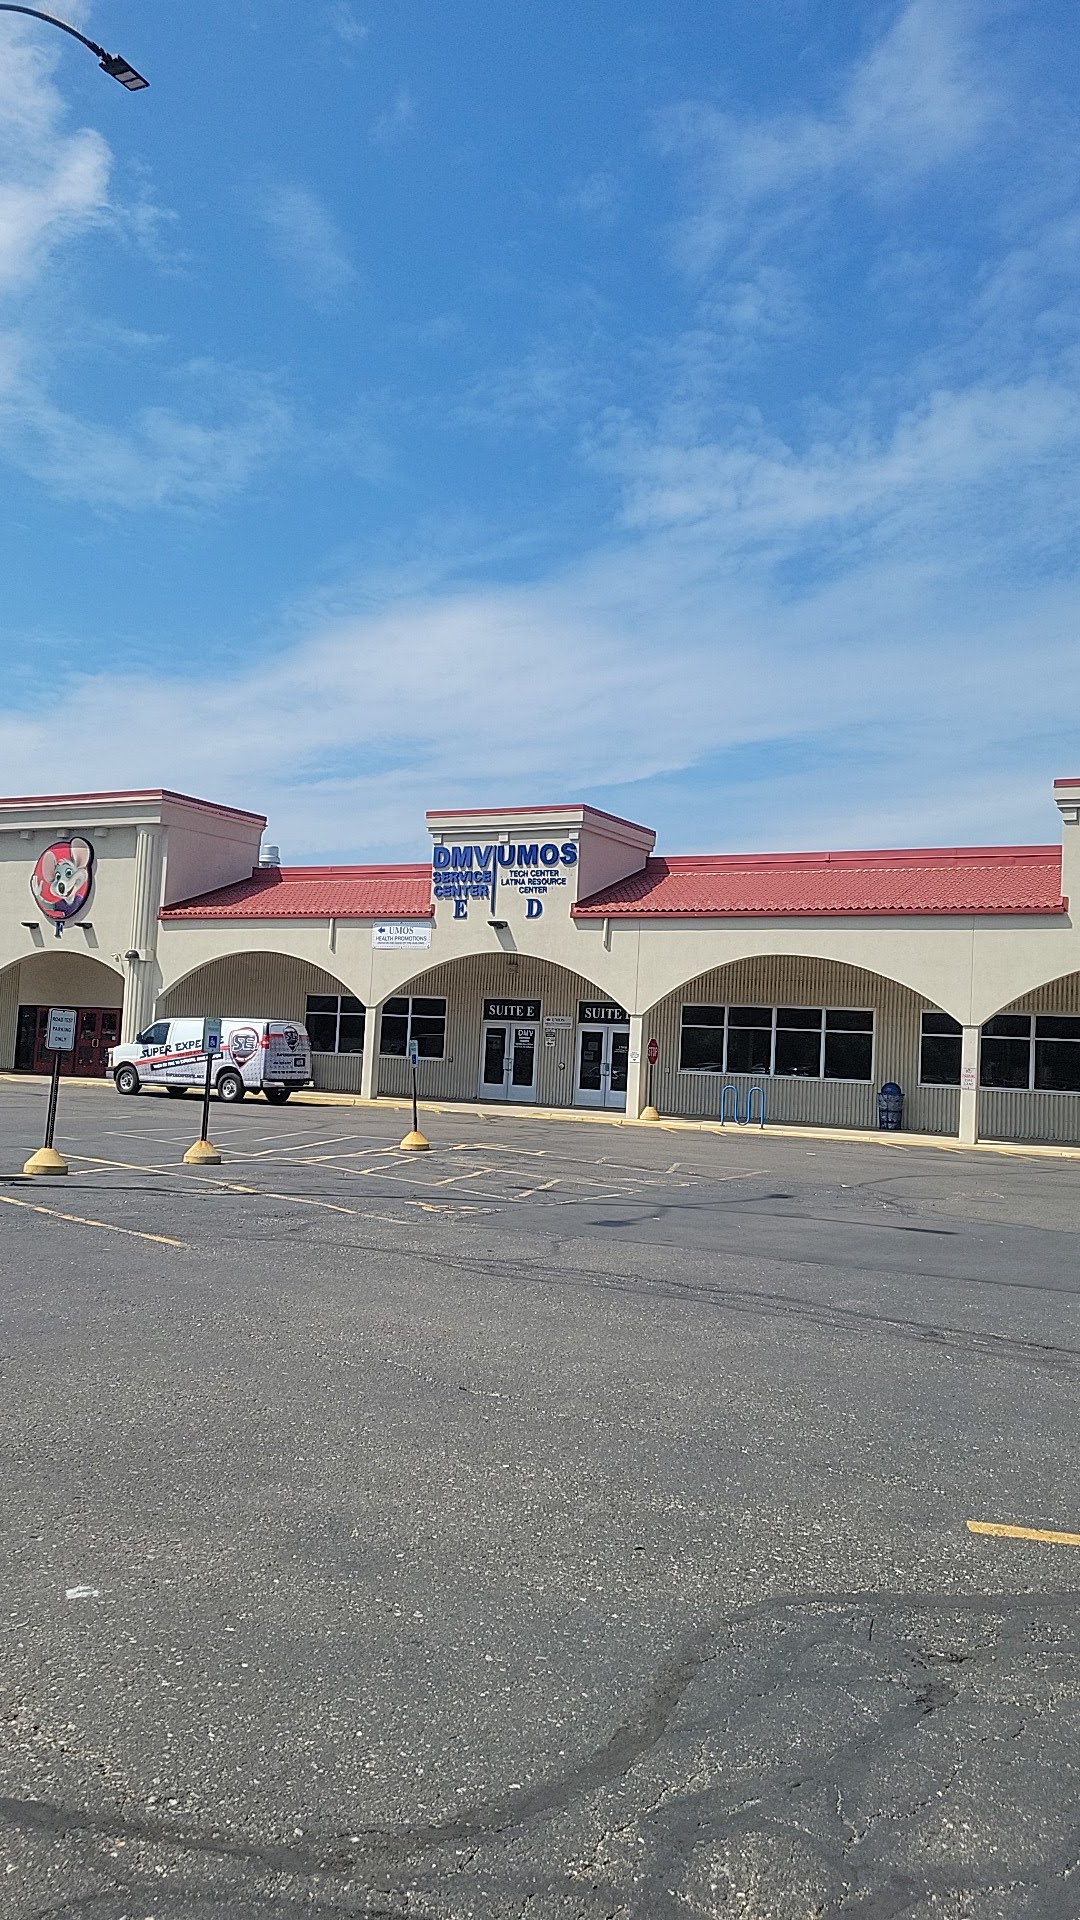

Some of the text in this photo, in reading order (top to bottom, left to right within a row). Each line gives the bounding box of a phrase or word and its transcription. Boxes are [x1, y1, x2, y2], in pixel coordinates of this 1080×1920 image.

[433, 845, 493, 868] DMV
[497, 843, 578, 866] UMOS
[433, 870, 492, 884] SERVICE
[530, 869, 559, 877] CENTER
[501, 877, 566, 886] LATINA RESOURCE
[433, 884, 489, 897] CENTER
[519, 886, 547, 894] CENTER
[453, 900, 468, 918] E
[526, 899, 543, 918] D
[55, 921, 65, 939] F
[389, 926, 414, 935] UMOS
[489, 1004, 535, 1017] SUITE E
[584, 1007, 622, 1020] SUITE
[140, 1044, 172, 1059] SUPER
[648, 1046, 658, 1057] STOP
